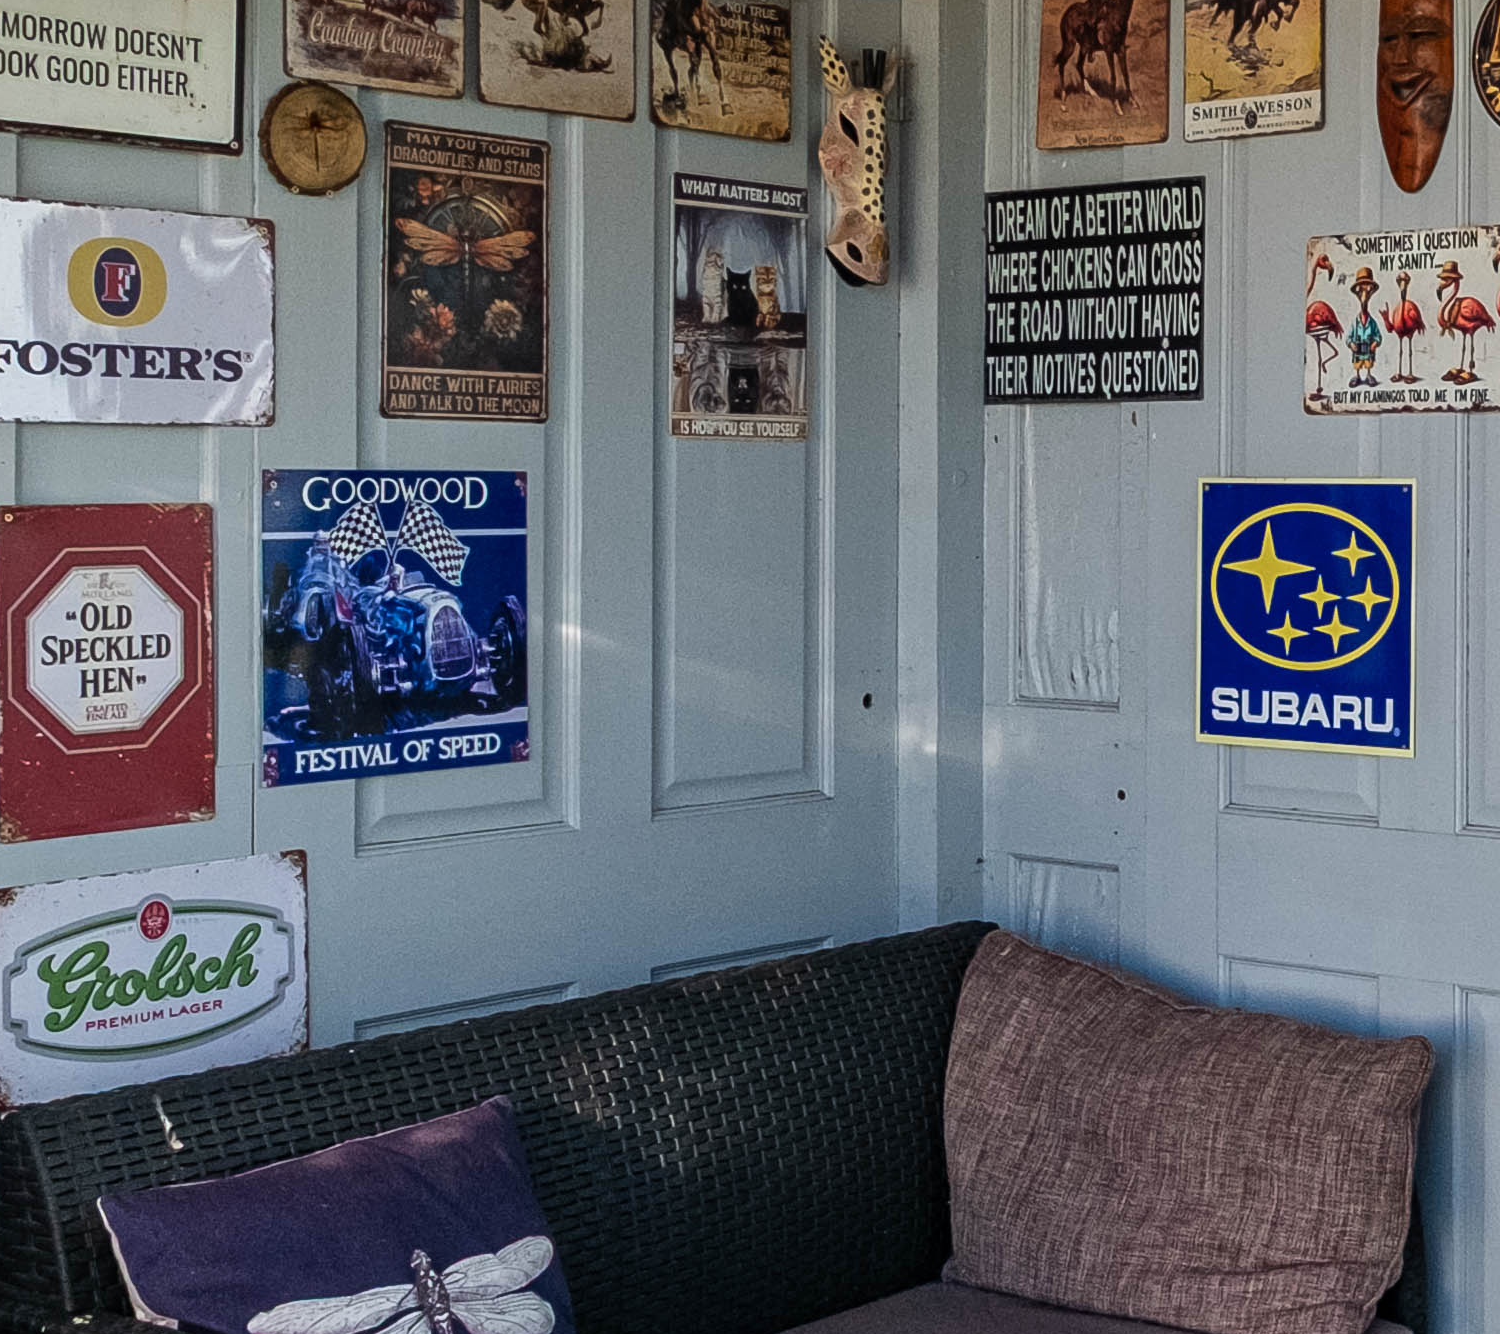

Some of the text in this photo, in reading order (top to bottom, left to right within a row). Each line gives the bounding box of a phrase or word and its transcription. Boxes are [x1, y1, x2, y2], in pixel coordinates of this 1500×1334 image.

[115, 27, 203, 63] DOESN'T
[309, 11, 444, 67] Cowboy Country
[47, 55, 109, 87] GOOD
[117, 63, 194, 98] EITHER.
[1192, 105, 1237, 121] SMITH
[1254, 97, 1312, 114] WESSON
[681, 179, 802, 207] WHAT MATTERS MOST
[996, 198, 1047, 242] DREAM
[1051, 196, 1069, 239] OF
[1073, 195, 1083, 237] A
[1086, 191, 1143, 236] BETTER
[1145, 186, 1202, 232] WORLD
[1355, 235, 1413, 254] SOMETIMES
[1423, 230, 1478, 251] QUESTION
[988, 240, 1201, 294] WHERE CHICKENS CAN CROSS
[988, 292, 1199, 343] THE ROAD WITHOUT HAVING
[389, 374, 540, 395] DANCE WITH FAIRIES
[987, 349, 1199, 399] THEIR MOTIVES QUESTIONED
[302, 476, 488, 511] GOODWOOD
[41, 633, 171, 666] SPECKLED
[1212, 687, 1393, 733] SUBARU
[295, 733, 501, 774] FESTIVAL OF SPEED
[37, 923, 261, 1032] Grolsch
[85, 999, 223, 1031] PREMIUM LAGER
